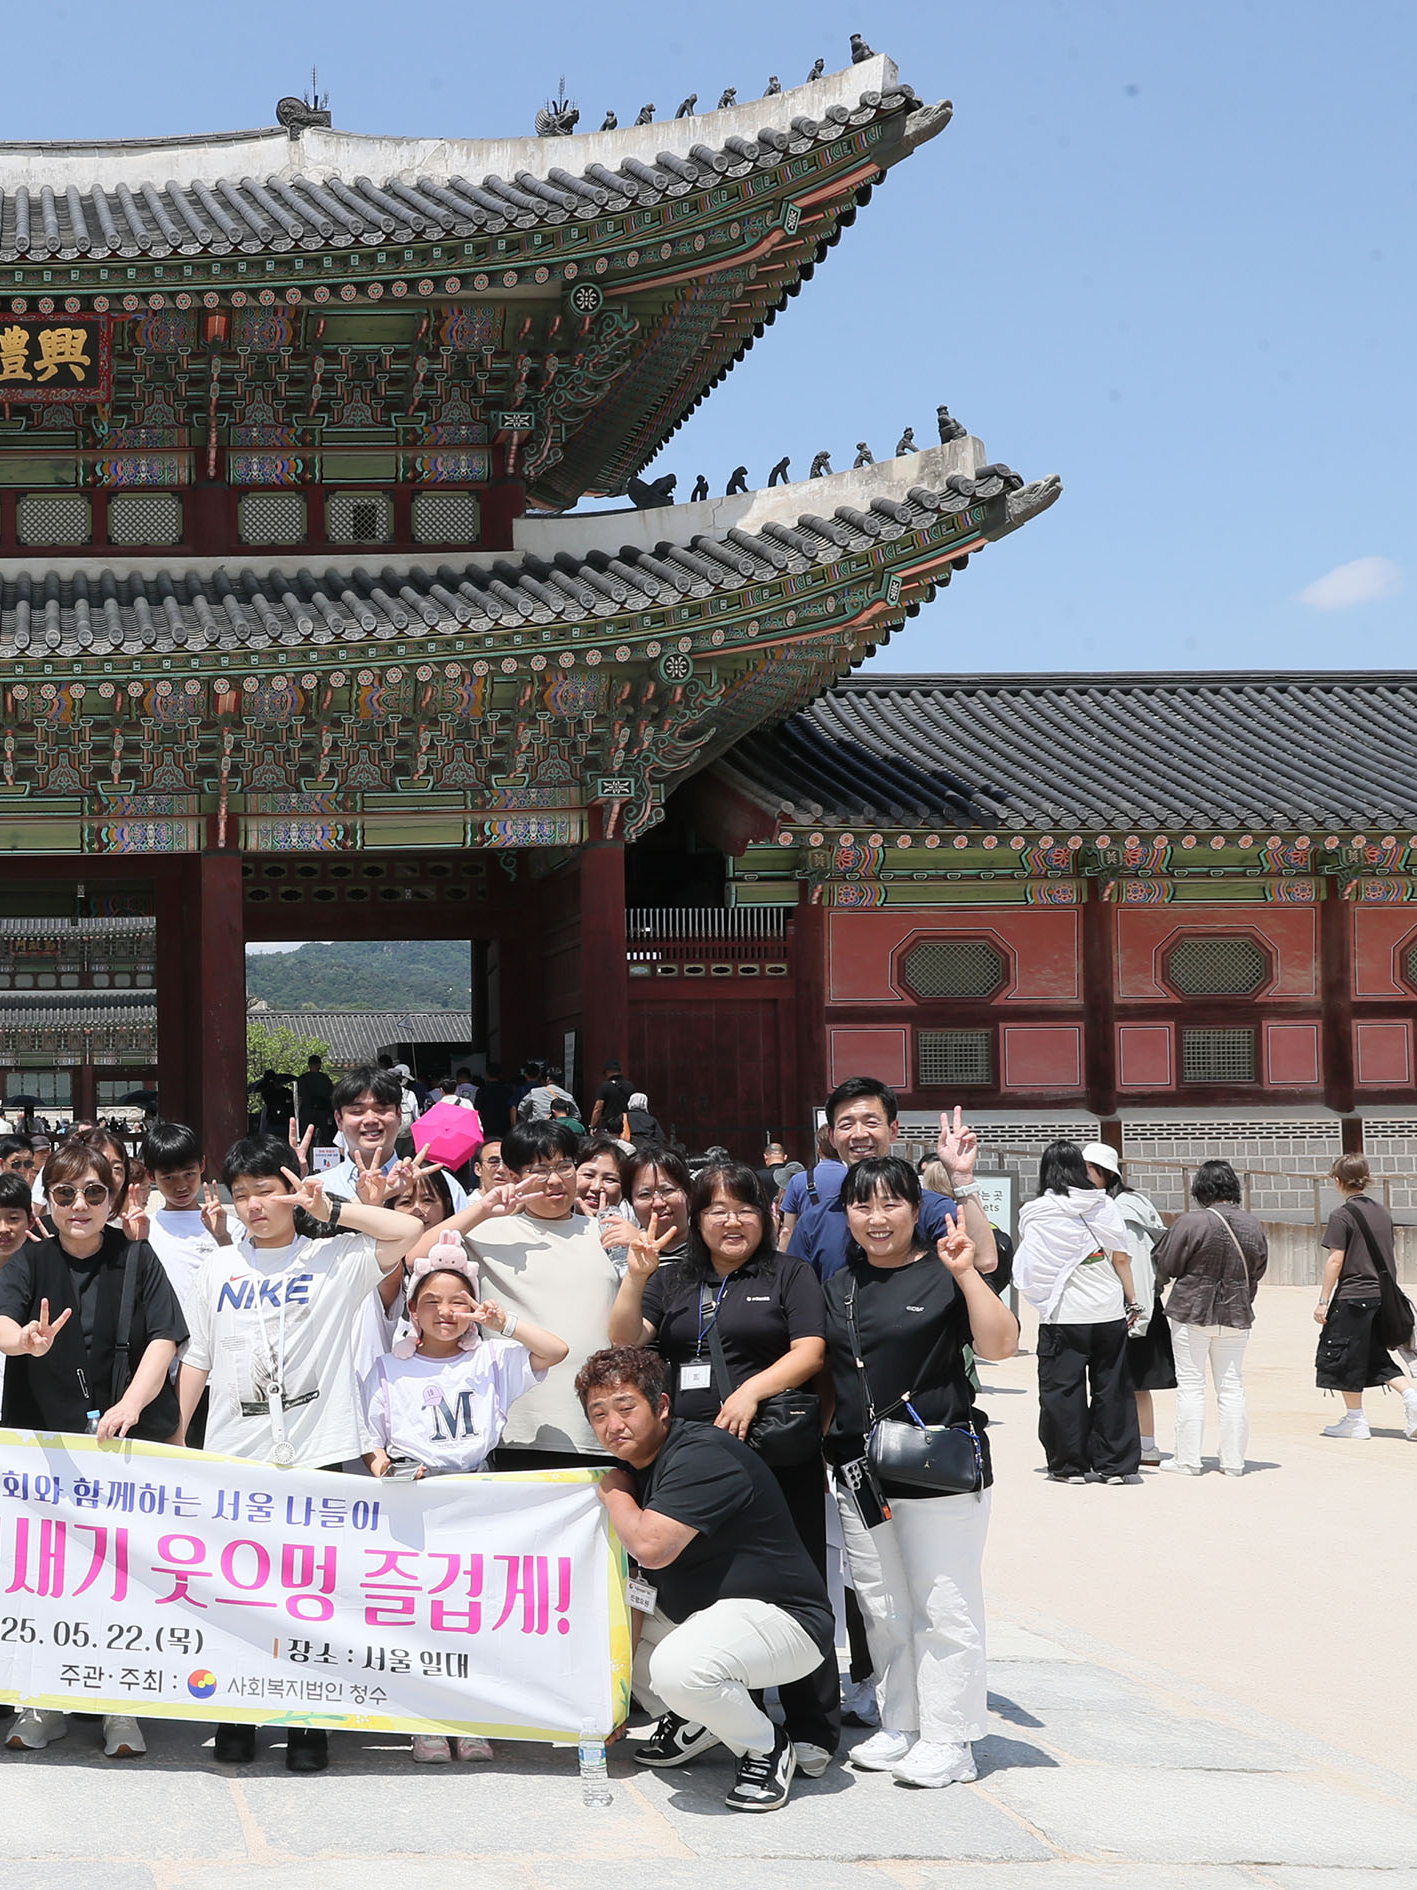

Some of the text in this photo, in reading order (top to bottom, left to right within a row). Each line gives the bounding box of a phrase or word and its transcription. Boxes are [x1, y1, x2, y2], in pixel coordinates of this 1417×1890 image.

[217, 1274, 313, 1312] NIKE
[72, 1476, 202, 1519] 함께하는
[211, 1489, 276, 1523] 서울
[285, 1494, 381, 1532] 나들이
[151, 1533, 338, 1622] 웃으멍
[360, 1548, 573, 1636] 즐겁게!
[52, 1619, 100, 1650] 05.
[361, 1646, 412, 1675] 서울
[420, 1650, 470, 1680] 일대
[227, 1675, 343, 1704] 사회복지법인
[350, 1684, 388, 1706] 청수
